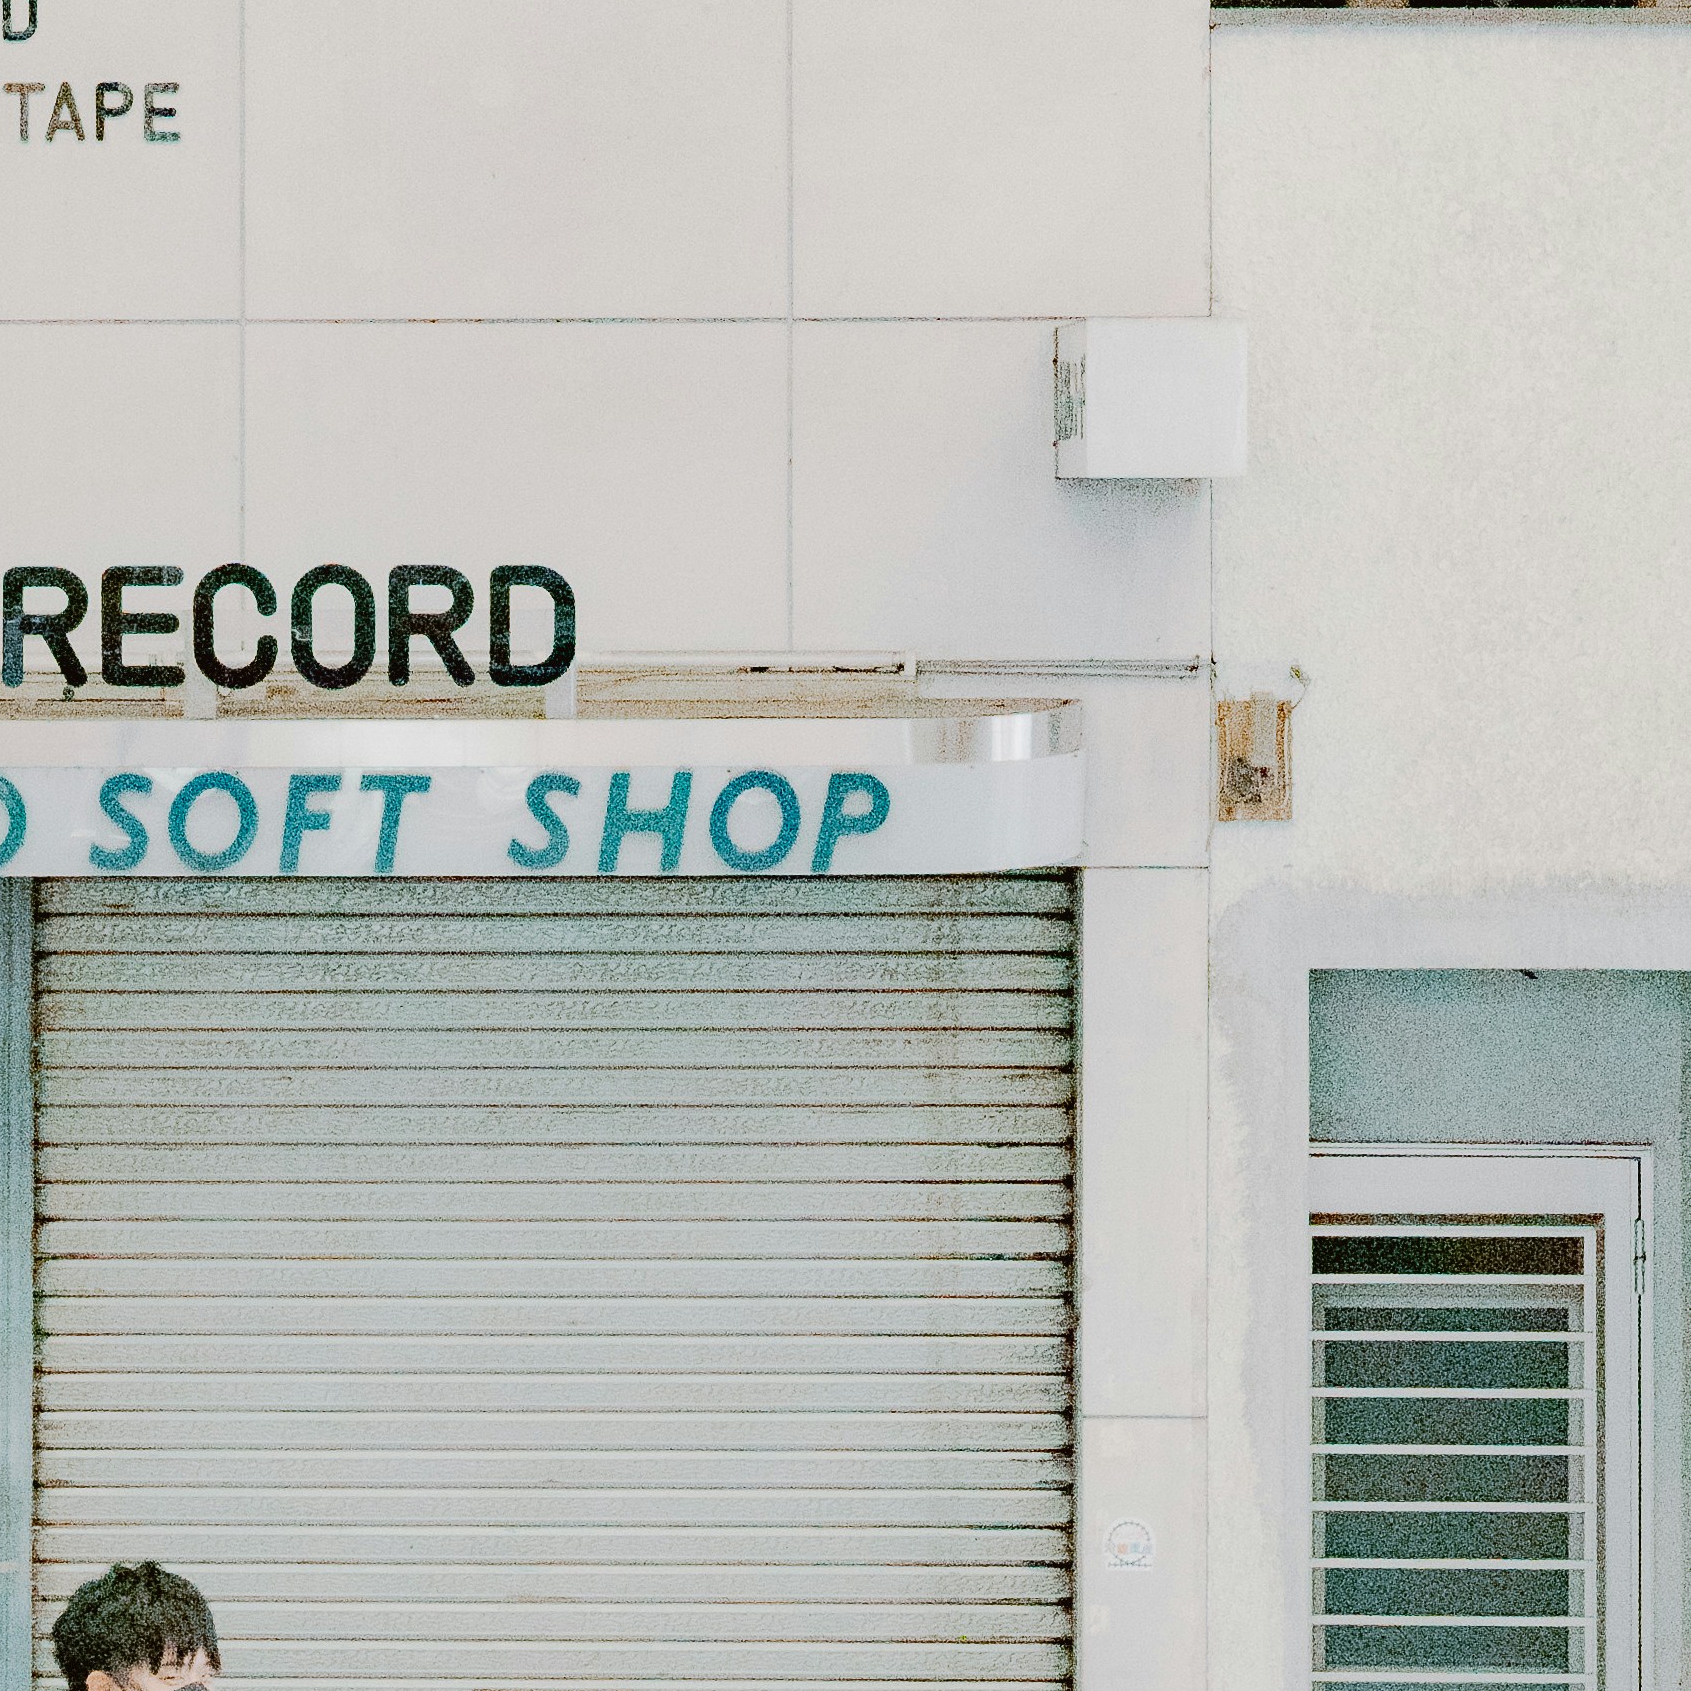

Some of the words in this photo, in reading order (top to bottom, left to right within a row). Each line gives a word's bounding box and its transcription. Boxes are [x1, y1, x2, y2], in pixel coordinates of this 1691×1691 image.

[3, 81, 180, 142] TAPE
[2, 564, 576, 689] RECORD
[85, 771, 432, 872] SOFT
[506, 770, 892, 872] SHOP
